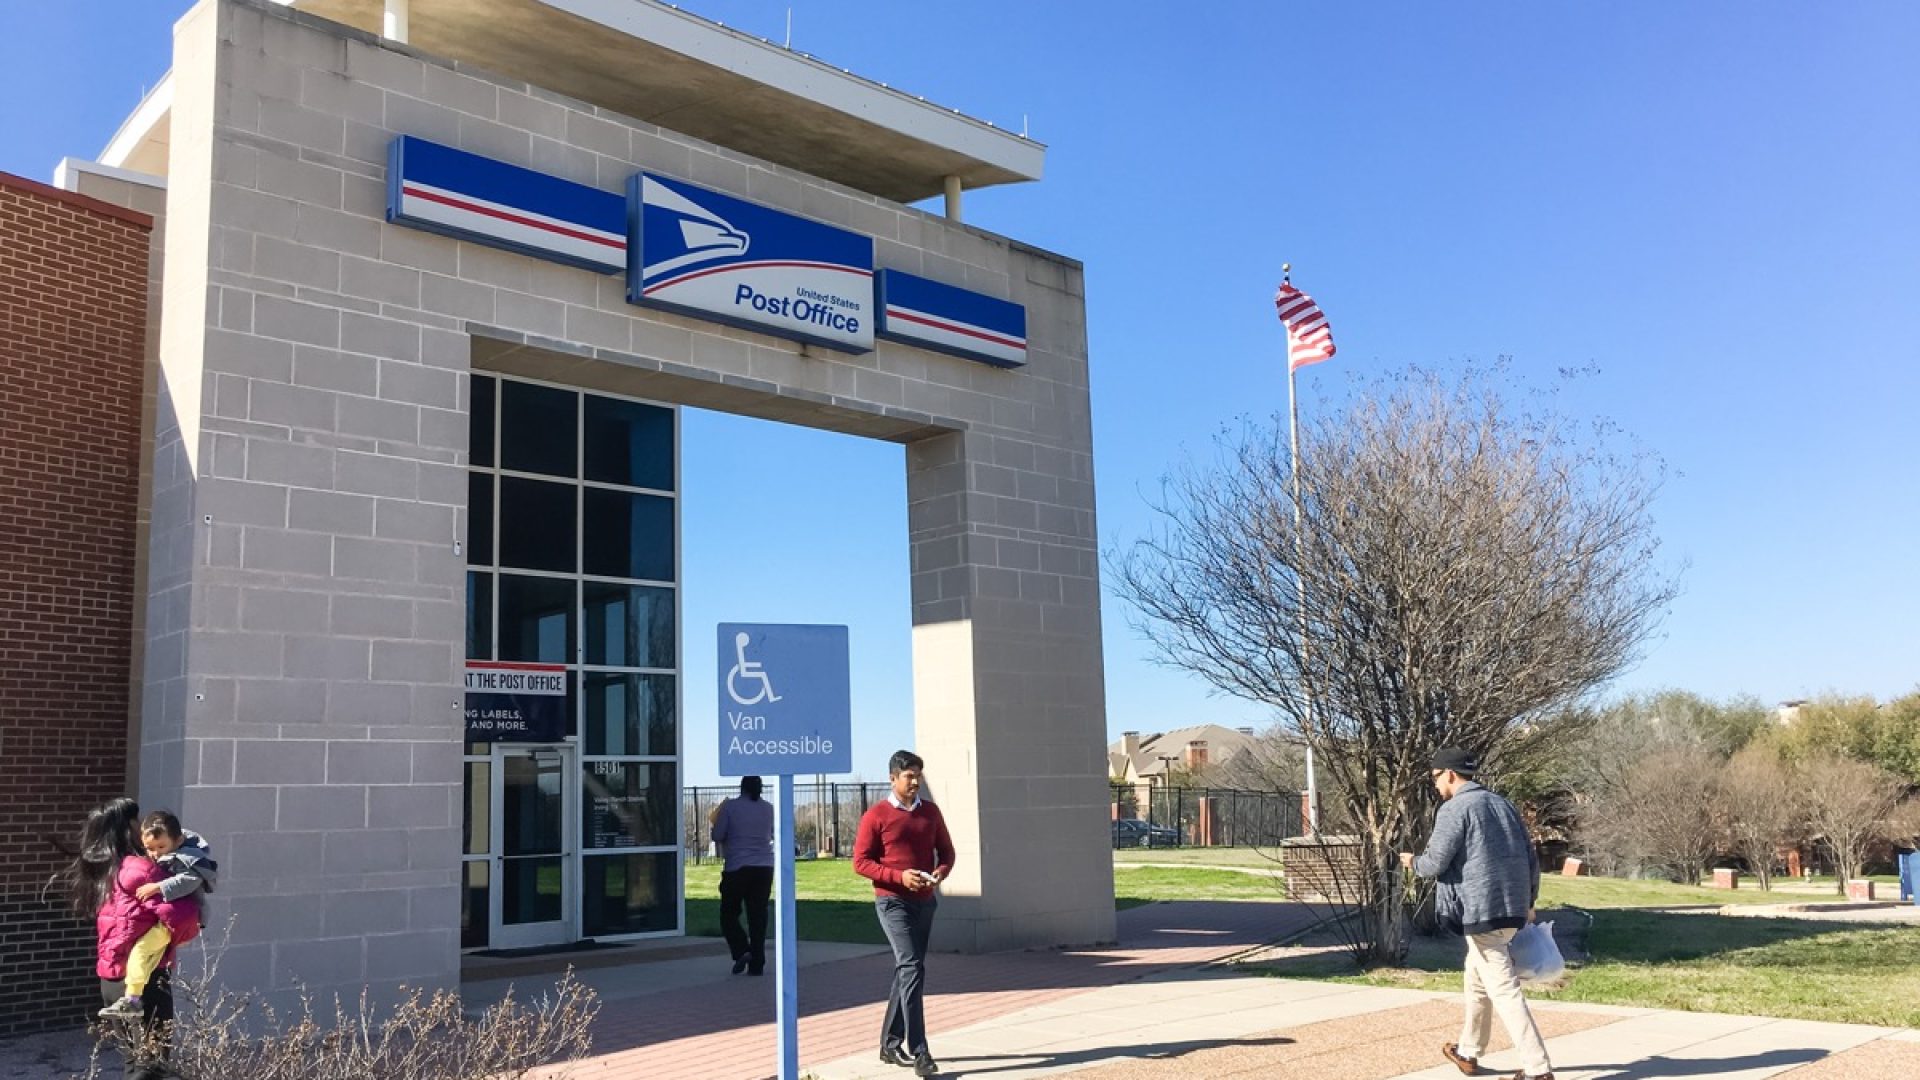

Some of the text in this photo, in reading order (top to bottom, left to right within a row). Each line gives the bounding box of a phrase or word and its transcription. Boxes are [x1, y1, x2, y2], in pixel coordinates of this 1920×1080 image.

[735, 283, 859, 333] Post Office
[796, 287, 860, 311] United States
[477, 673, 497, 689] THE
[500, 673, 525, 690] POST
[527, 675, 563, 691] OFFICE
[481, 709, 522, 720] LABELS,
[727, 711, 766, 731] Van
[471, 721, 494, 730] AND
[497, 721, 529, 731] MORE.
[727, 735, 833, 755] Accessible
